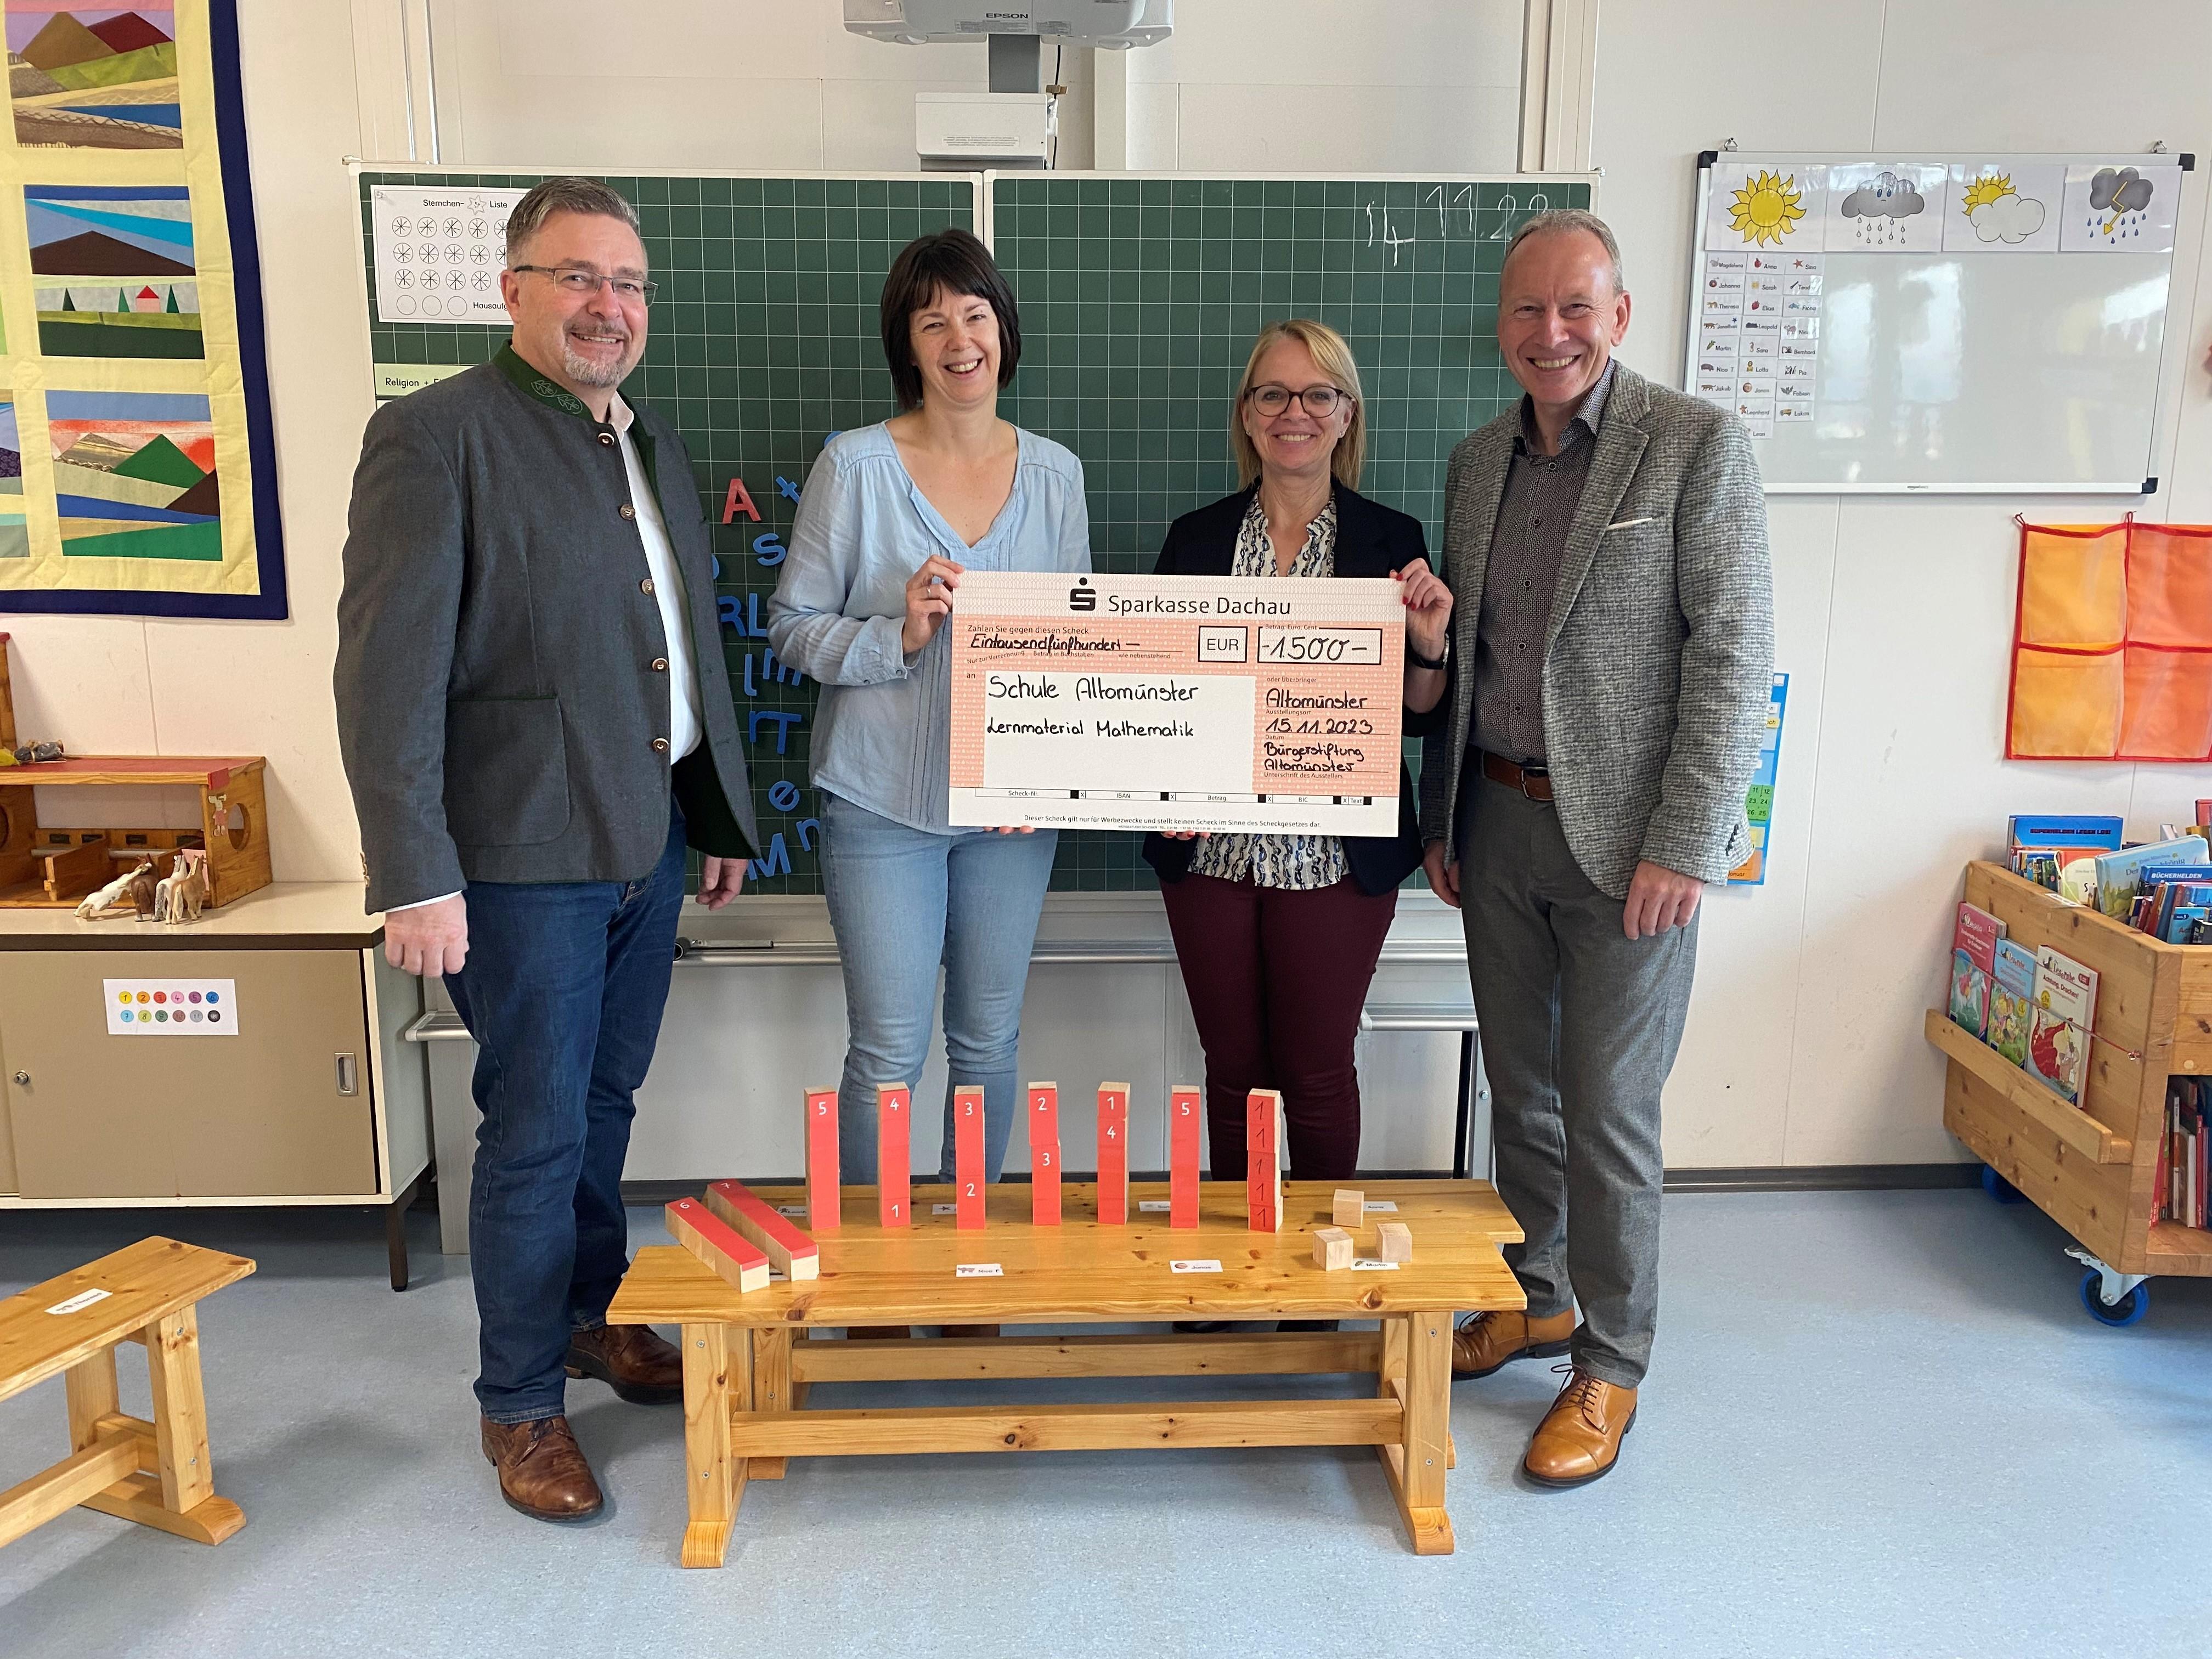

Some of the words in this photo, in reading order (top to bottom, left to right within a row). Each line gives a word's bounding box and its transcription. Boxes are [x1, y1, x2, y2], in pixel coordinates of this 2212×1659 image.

[423, 199, 464, 207] Sternchen-
[386, 377, 419, 388] Religion
[722, 478, 762, 524] A
[1108, 595, 1210, 617] Sparkasse
[1217, 597, 1290, 615] Dachau
[968, 624, 994, 633] Zahlen
[1009, 627, 1034, 635] gegen
[1035, 626, 1060, 634] diesen
[1062, 627, 1089, 635] Scheck
[1206, 638, 1239, 651] EUR
[988, 650, 1025, 661] Verrechnung
[989, 674, 1059, 698] Schule
[1076, 676, 1199, 702] Altomünster
[1266, 688, 1368, 709] Altomünster
[988, 717, 1084, 735] Lernmaterial
[1097, 719, 1194, 737] Mathematik
[1263, 742, 1364, 762] Bürgerstiftung
[818, 1102, 827, 1115] 5
[890, 1098, 899, 1111] 4
[965, 1102, 973, 1115] 3
[1038, 1097, 1047, 1111] 2
[1107, 1097, 1114, 1110] 1
[1182, 1102, 1190, 1115] 5
[1255, 1101, 1263, 1120] 1
[1107, 1126, 1116, 1139] 4
[1256, 1128, 1265, 1147] 1
[1042, 1153, 1050, 1166] 3
[966, 1183, 975, 1197] 2
[1256, 1183, 1263, 1201] 1
[891, 1205, 899, 1218] 1
[1257, 1208, 1266, 1227] 1
